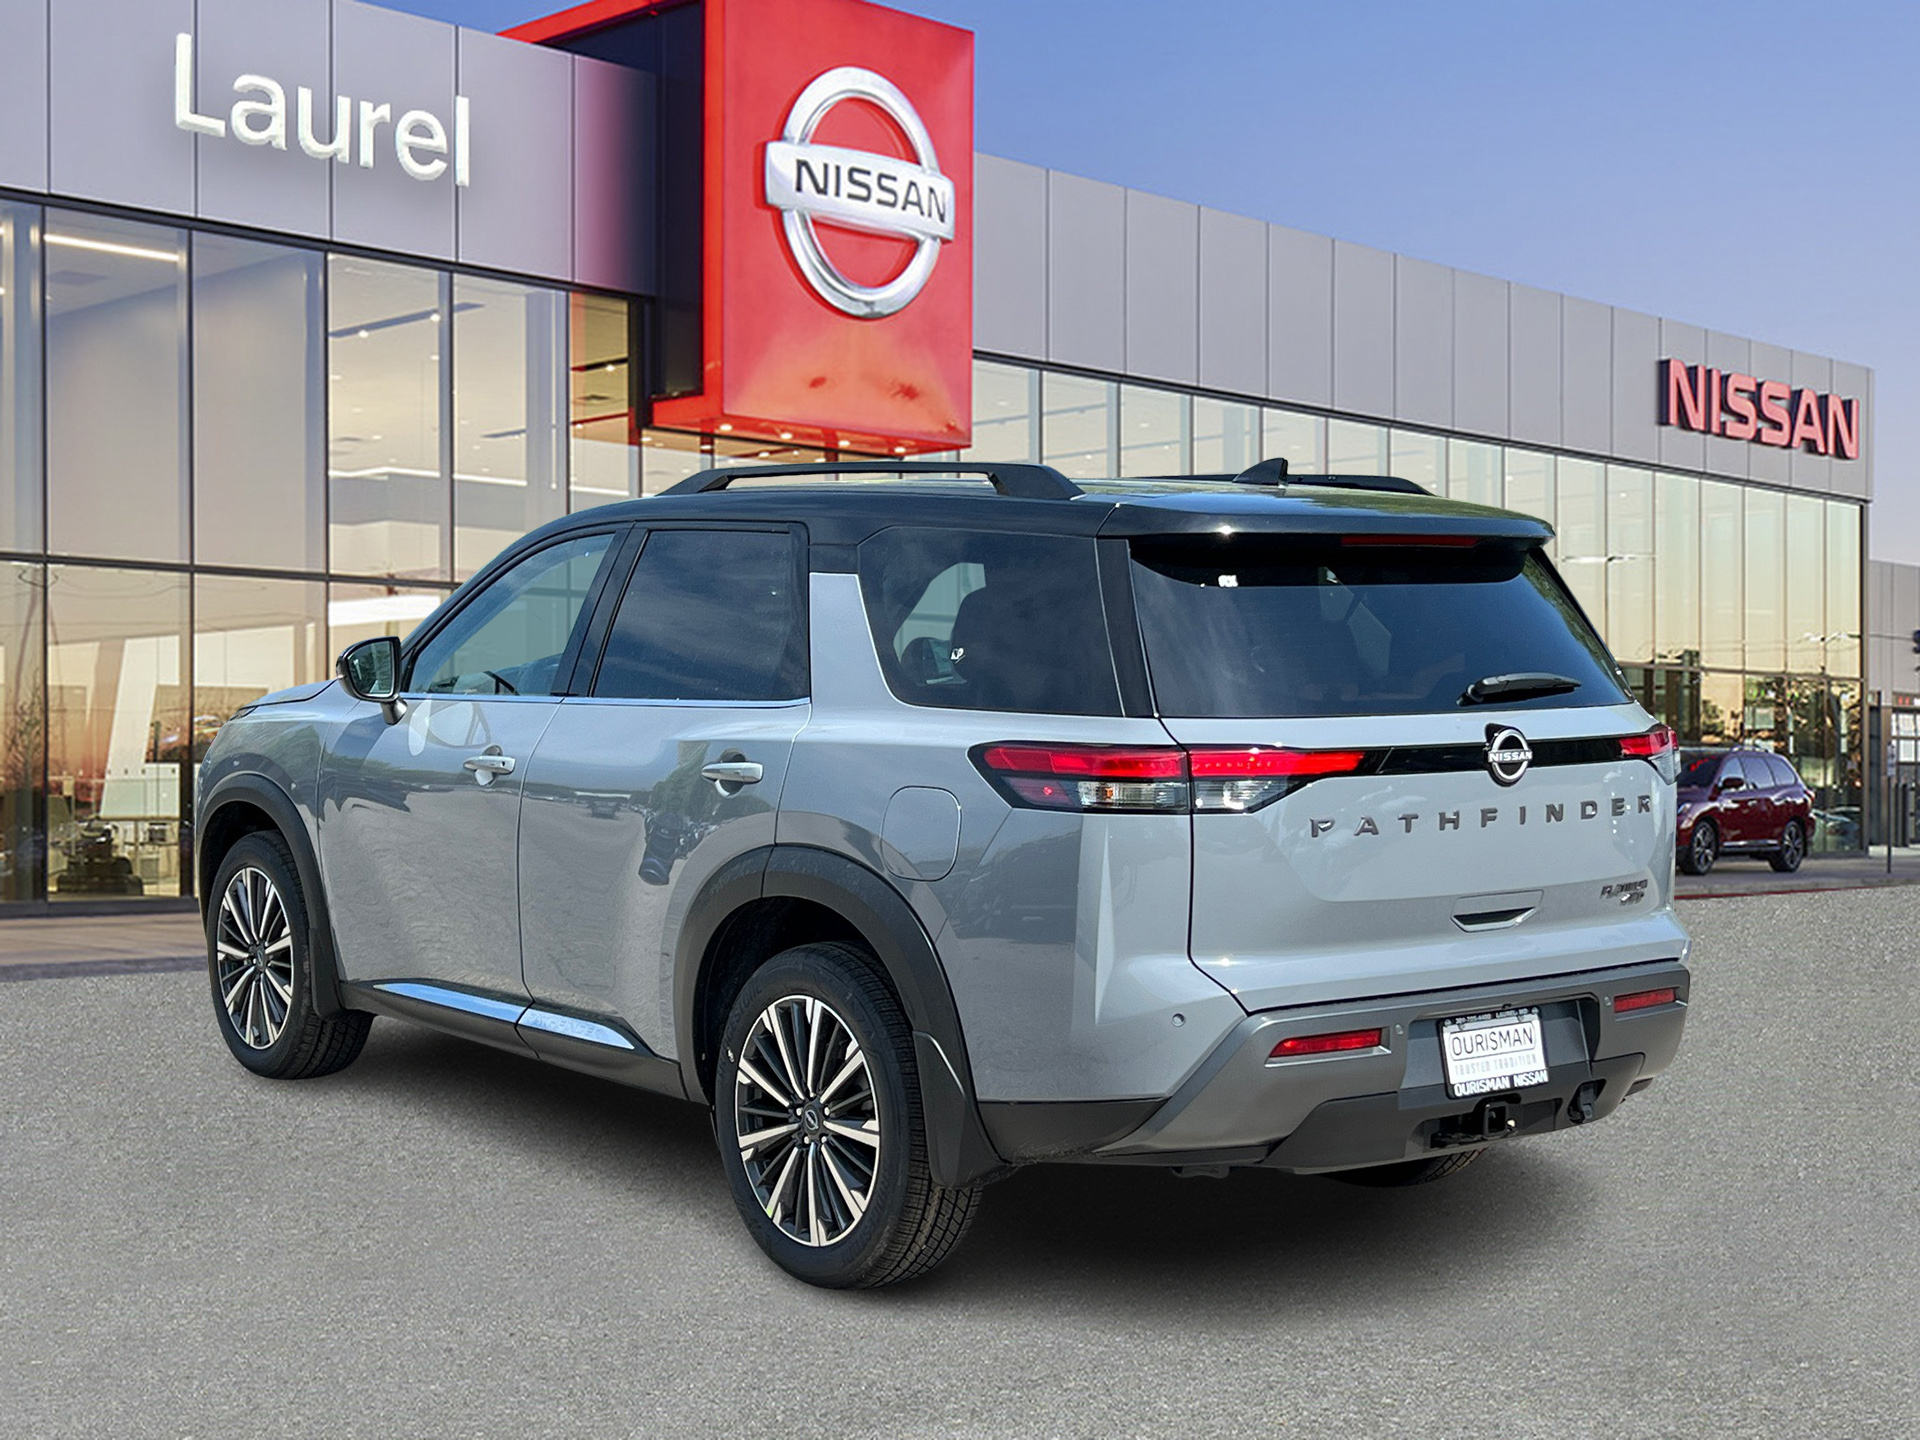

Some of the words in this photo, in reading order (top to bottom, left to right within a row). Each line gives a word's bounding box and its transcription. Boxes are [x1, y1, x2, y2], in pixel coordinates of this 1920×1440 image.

[175, 33, 471, 188] Laurel
[795, 158, 947, 224] NISSAN
[1660, 358, 1860, 460] NISSAN
[1488, 750, 1533, 763] NISSAN
[1310, 794, 1652, 838] PATHFINDER
[1452, 1027, 1533, 1056] OURISMAN
[1455, 1060, 1490, 1076] TRUSTED
[1495, 1054, 1537, 1070] TRADITION
[1453, 1076, 1511, 1098] OURISMAN
[1514, 1069, 1549, 1088] NISSAN
